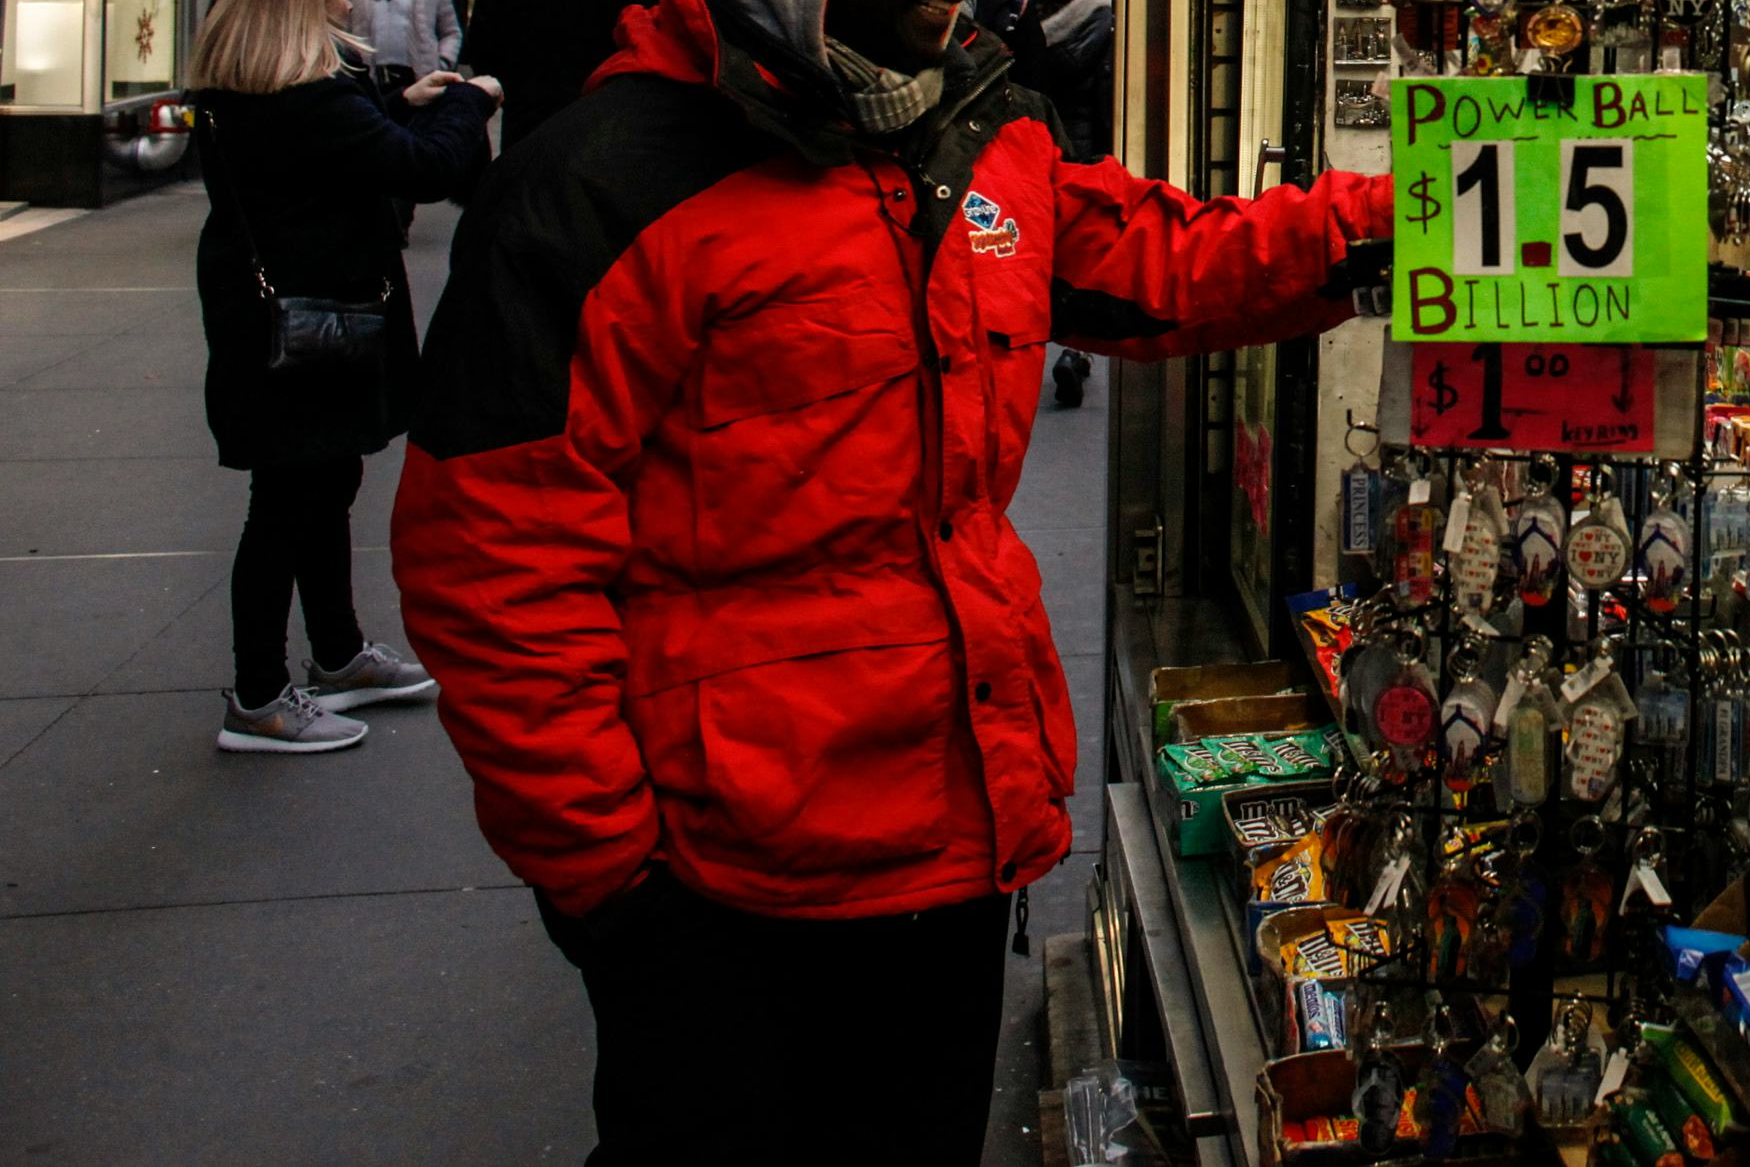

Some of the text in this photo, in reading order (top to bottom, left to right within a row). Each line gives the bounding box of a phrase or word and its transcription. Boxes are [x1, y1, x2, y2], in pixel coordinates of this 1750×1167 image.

[1408, 266, 1631, 335] BILLION
[1352, 477, 1368, 546] PRINCESS
[1303, 983, 1322, 1021] mentos
